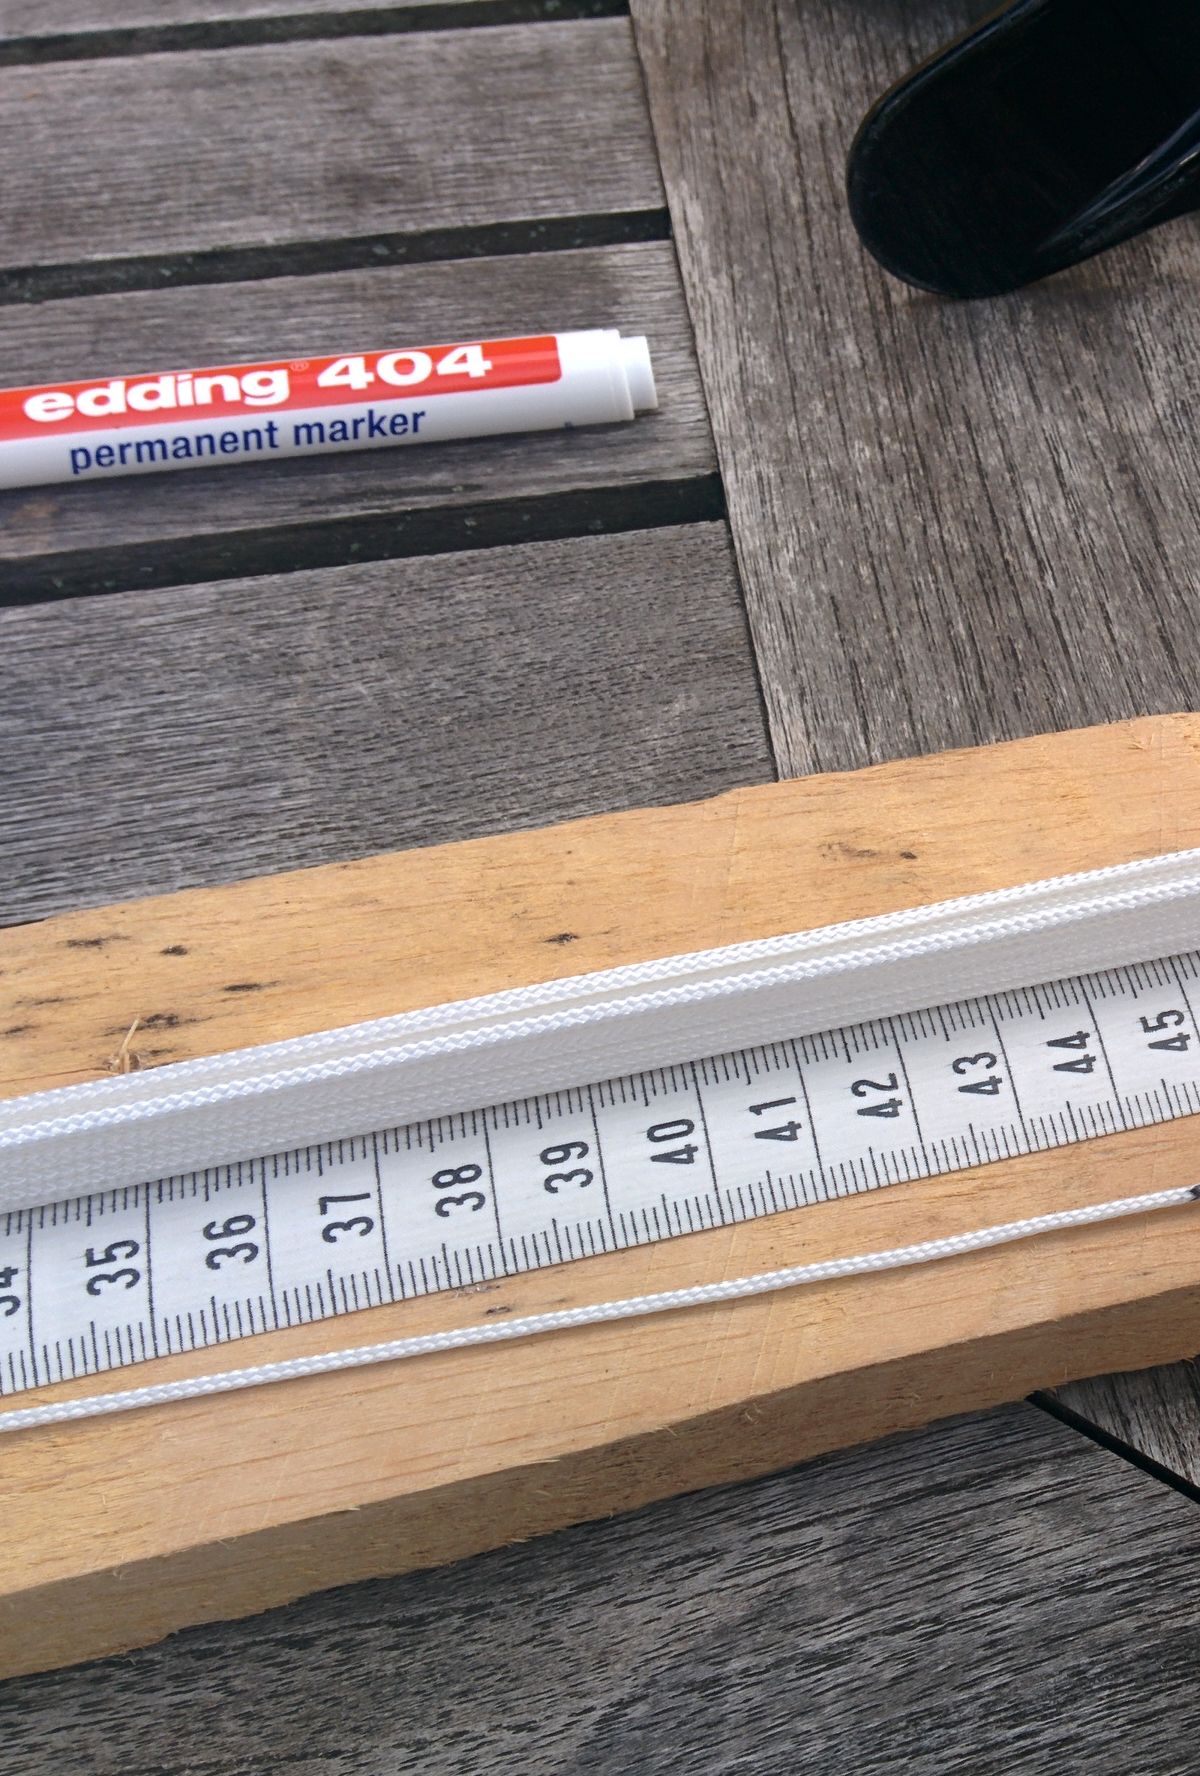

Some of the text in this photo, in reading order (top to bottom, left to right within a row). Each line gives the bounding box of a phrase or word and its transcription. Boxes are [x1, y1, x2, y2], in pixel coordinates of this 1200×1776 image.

[23, 345, 493, 423] edding 404
[69, 407, 426, 475] permanent marker
[1046, 1030, 1097, 1074] 44
[1139, 1008, 1191, 1052] 45
[850, 1072, 903, 1119] 42
[951, 1051, 1003, 1096] 43
[646, 1118, 699, 1165] 40
[748, 1096, 802, 1142] 41
[431, 1162, 486, 1218] 38
[539, 1141, 594, 1194] 39
[202, 1214, 259, 1270] 36
[318, 1192, 375, 1244] 37
[84, 1239, 141, 1296] 35
